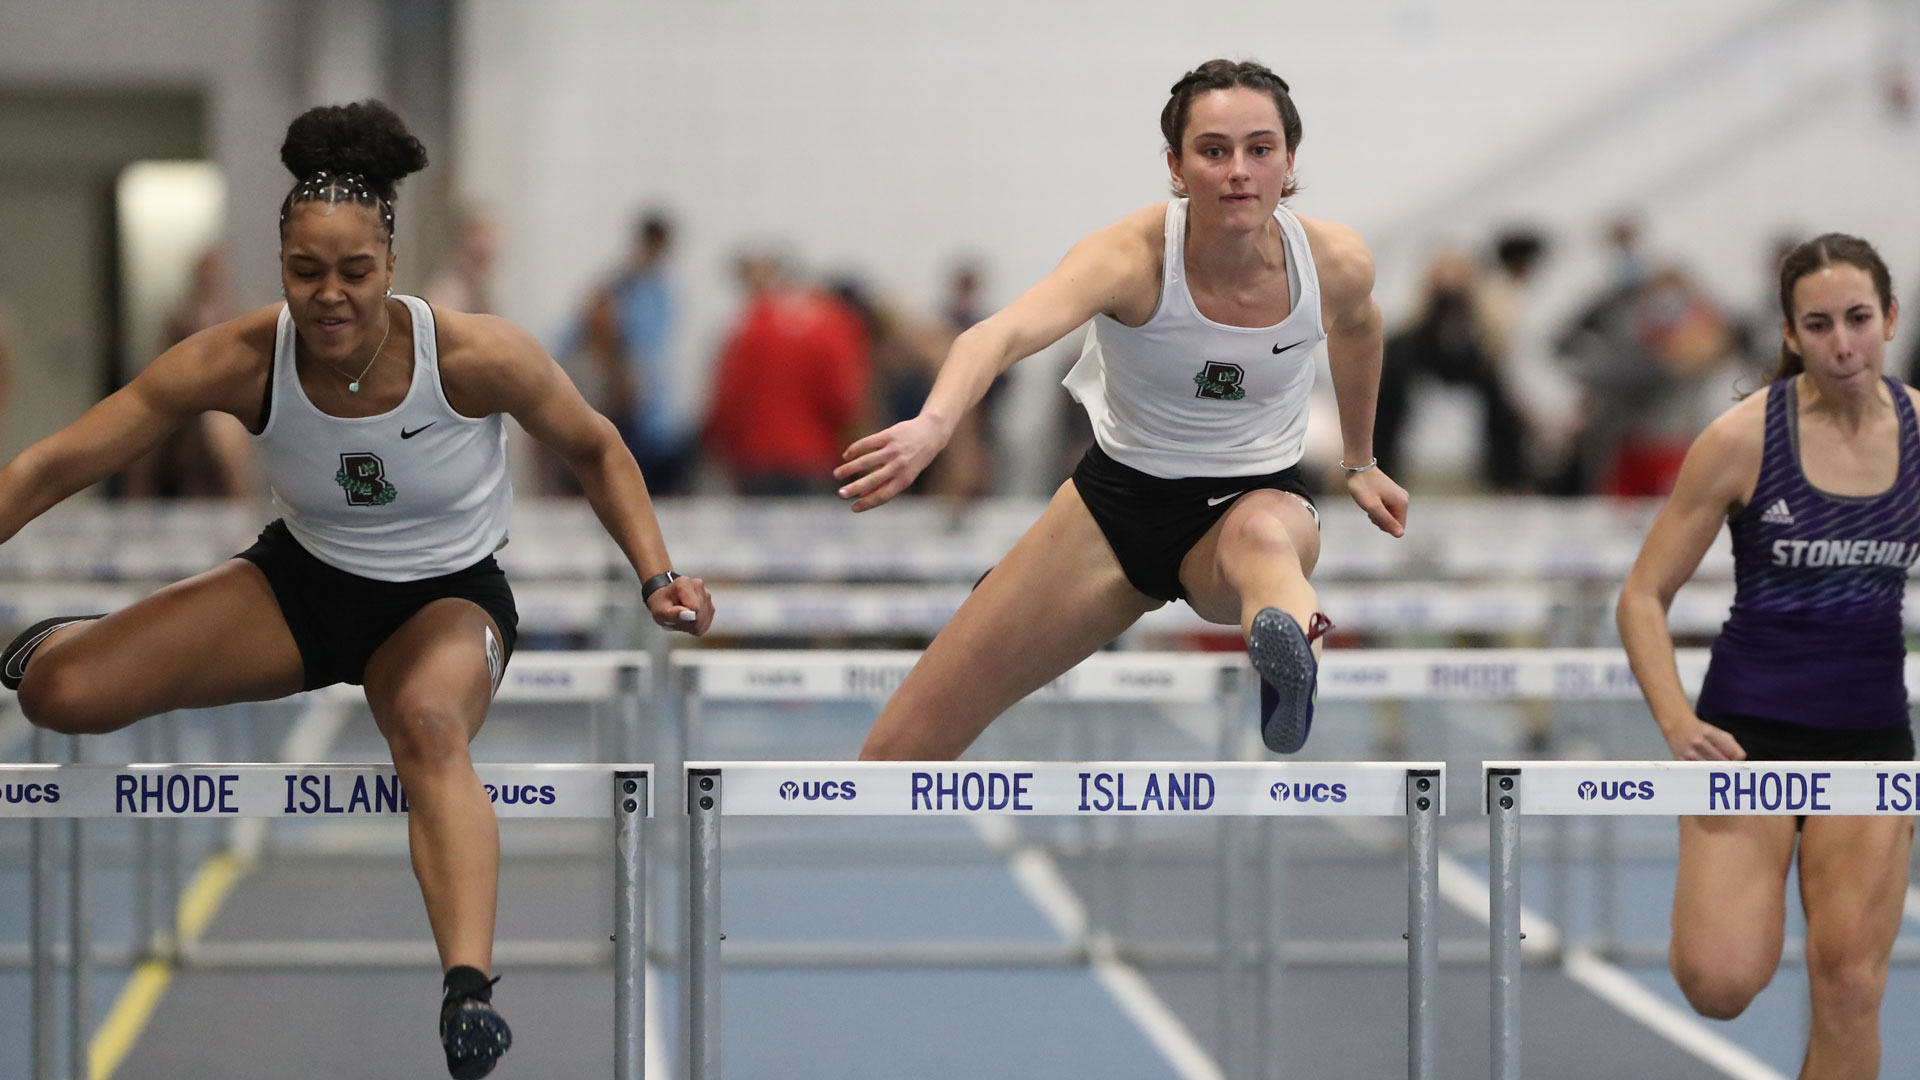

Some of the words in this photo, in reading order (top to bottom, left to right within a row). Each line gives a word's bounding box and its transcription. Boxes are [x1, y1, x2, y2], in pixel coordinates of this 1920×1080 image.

[5, 783, 61, 804] UCS
[115, 774, 240, 814] RHODE
[284, 774, 410, 814] ISLAN
[501, 784, 557, 805] UCS
[803, 780, 857, 801] UCS
[911, 771, 1034, 811] RHODE
[1078, 772, 1216, 812] ISLAND
[1293, 782, 1348, 803] UCS
[1600, 780, 1656, 801] UCS
[1709, 771, 1832, 811] RHODE
[1875, 772, 1920, 812] IS
